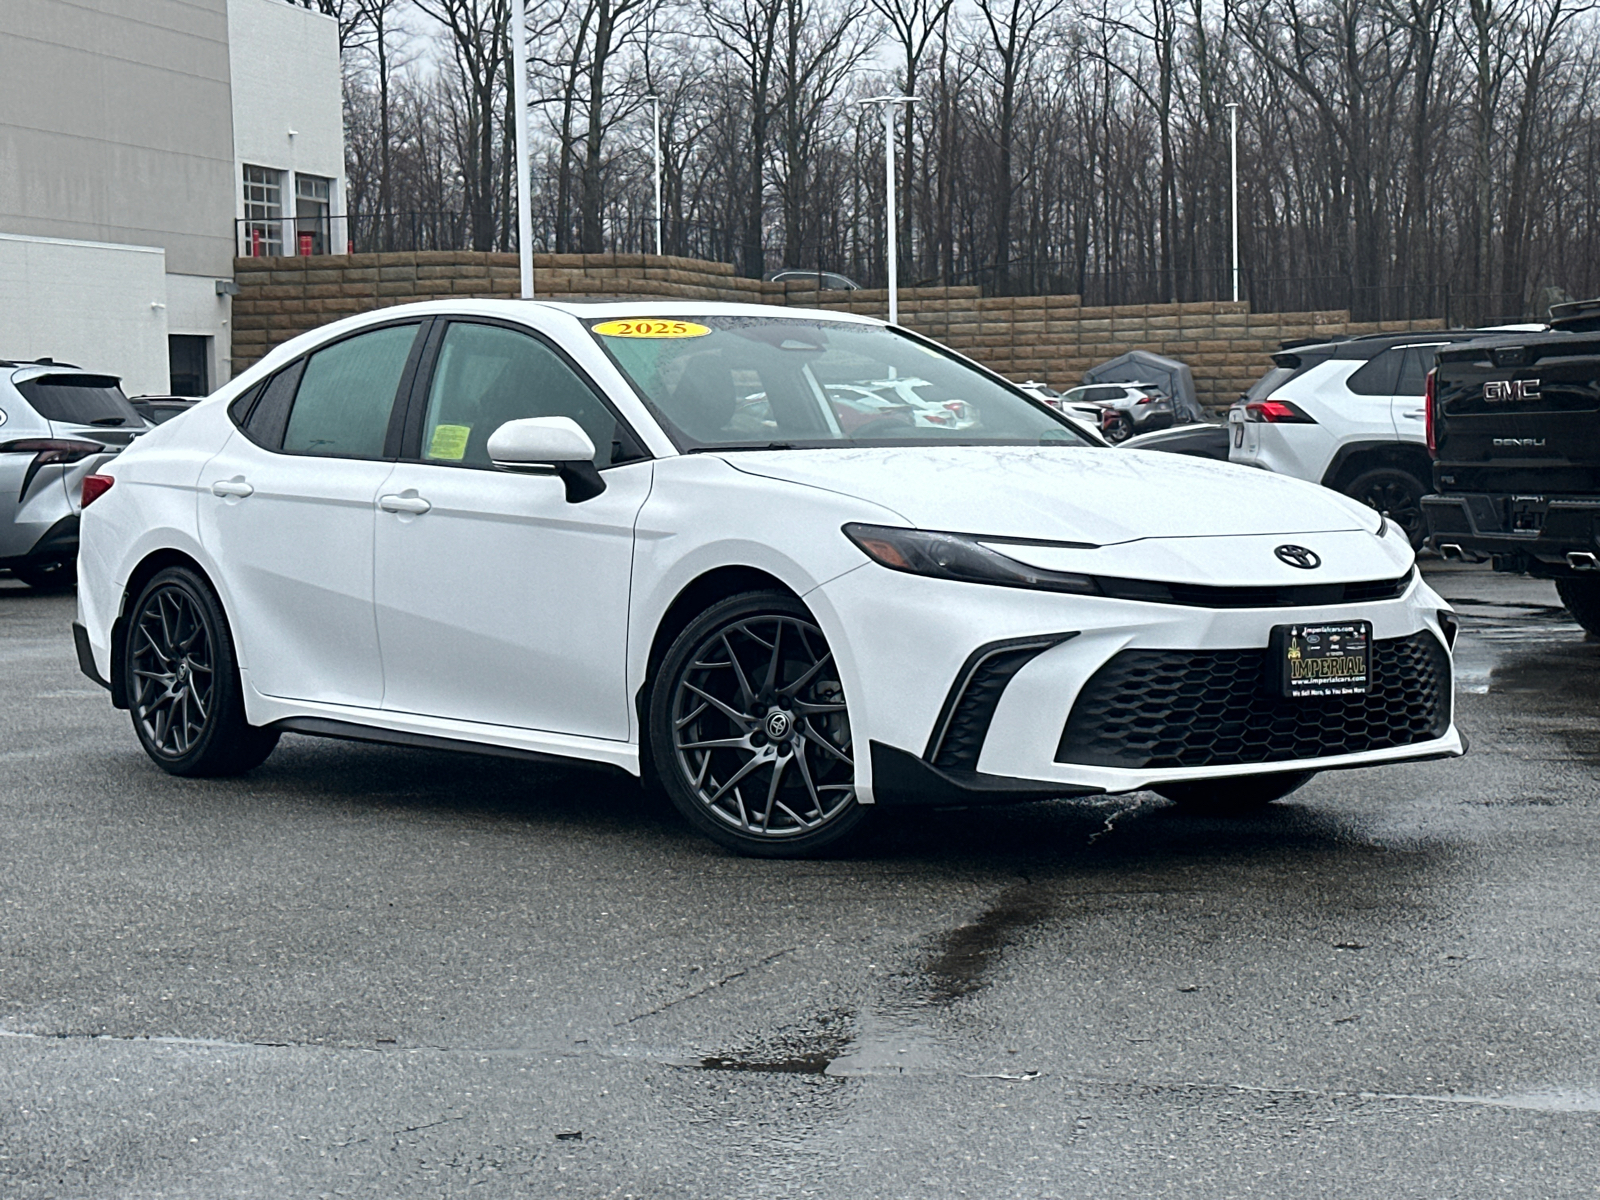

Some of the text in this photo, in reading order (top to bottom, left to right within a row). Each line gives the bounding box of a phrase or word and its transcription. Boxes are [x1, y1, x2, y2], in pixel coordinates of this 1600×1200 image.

[617, 323, 687, 334] 2025
[1483, 379, 1541, 402] GMC
[1493, 438, 1546, 446] DENALI
[1291, 656, 1366, 679] IMPERIAL
[1291, 676, 1366, 685] www.imperialcars.com
